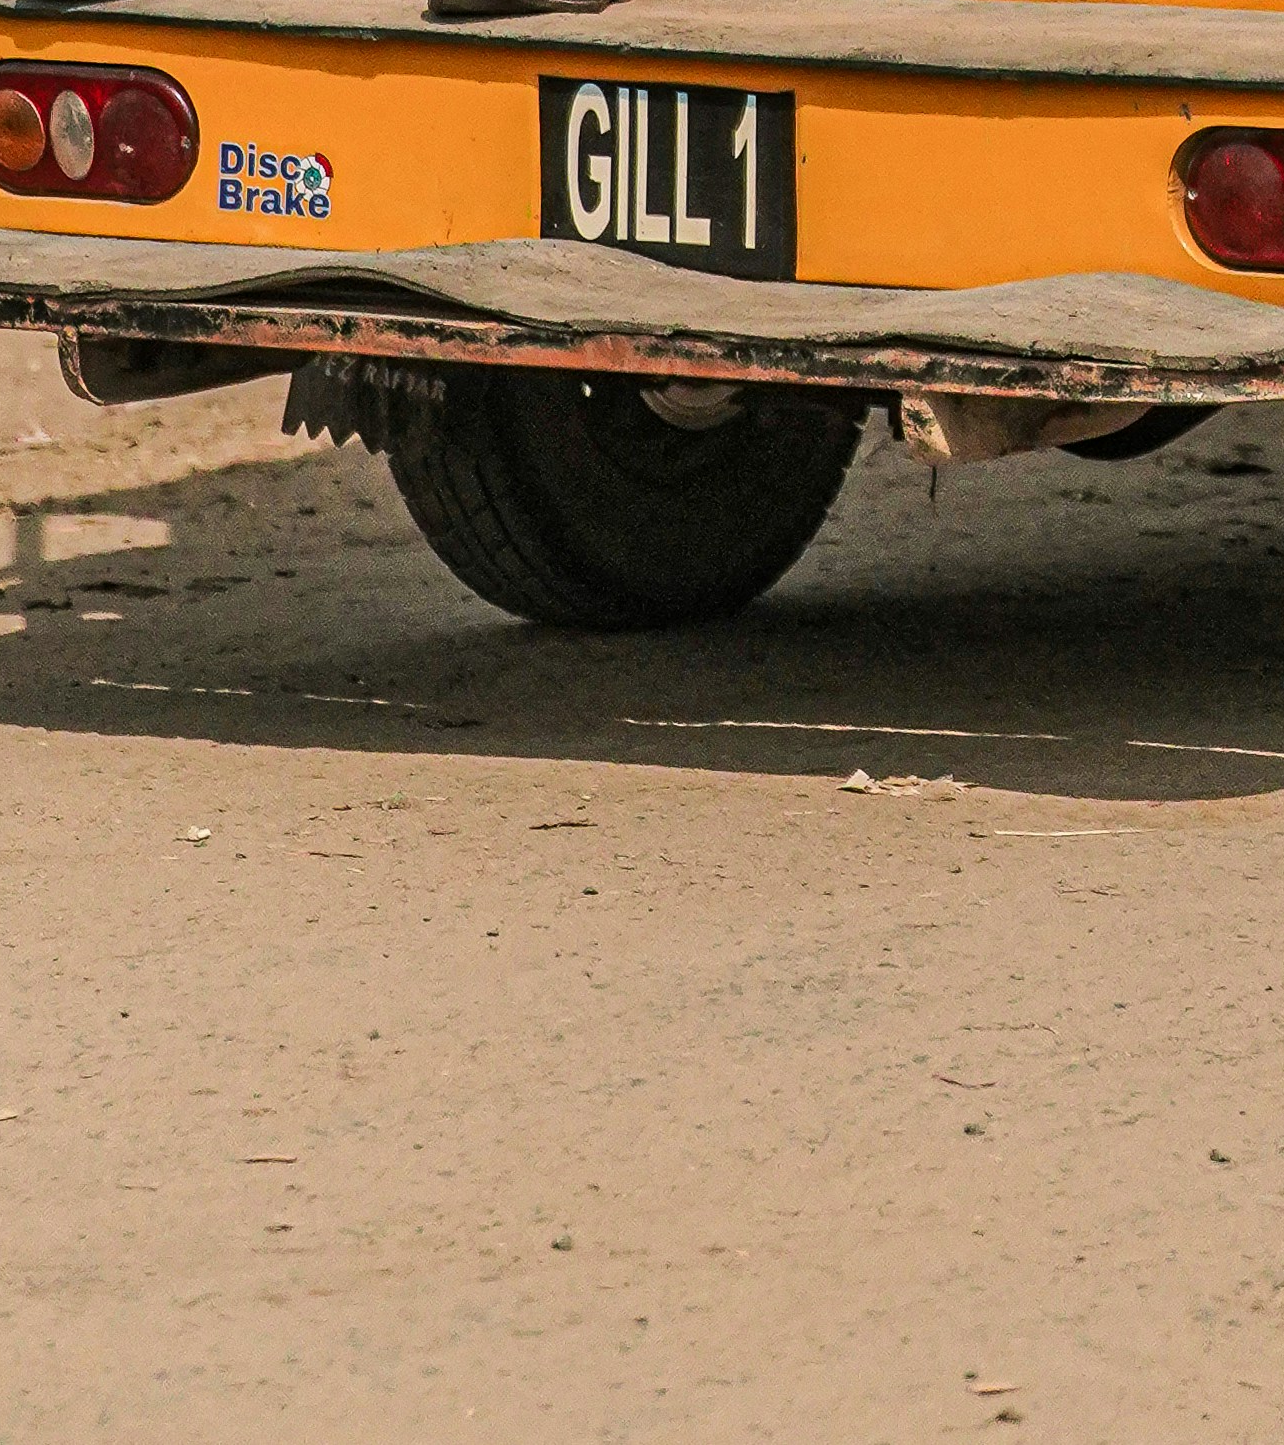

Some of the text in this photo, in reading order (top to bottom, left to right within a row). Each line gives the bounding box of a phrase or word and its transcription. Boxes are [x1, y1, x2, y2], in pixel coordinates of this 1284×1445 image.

[218, 177, 331, 220] Brake
[567, 82, 758, 250] GILL 1
